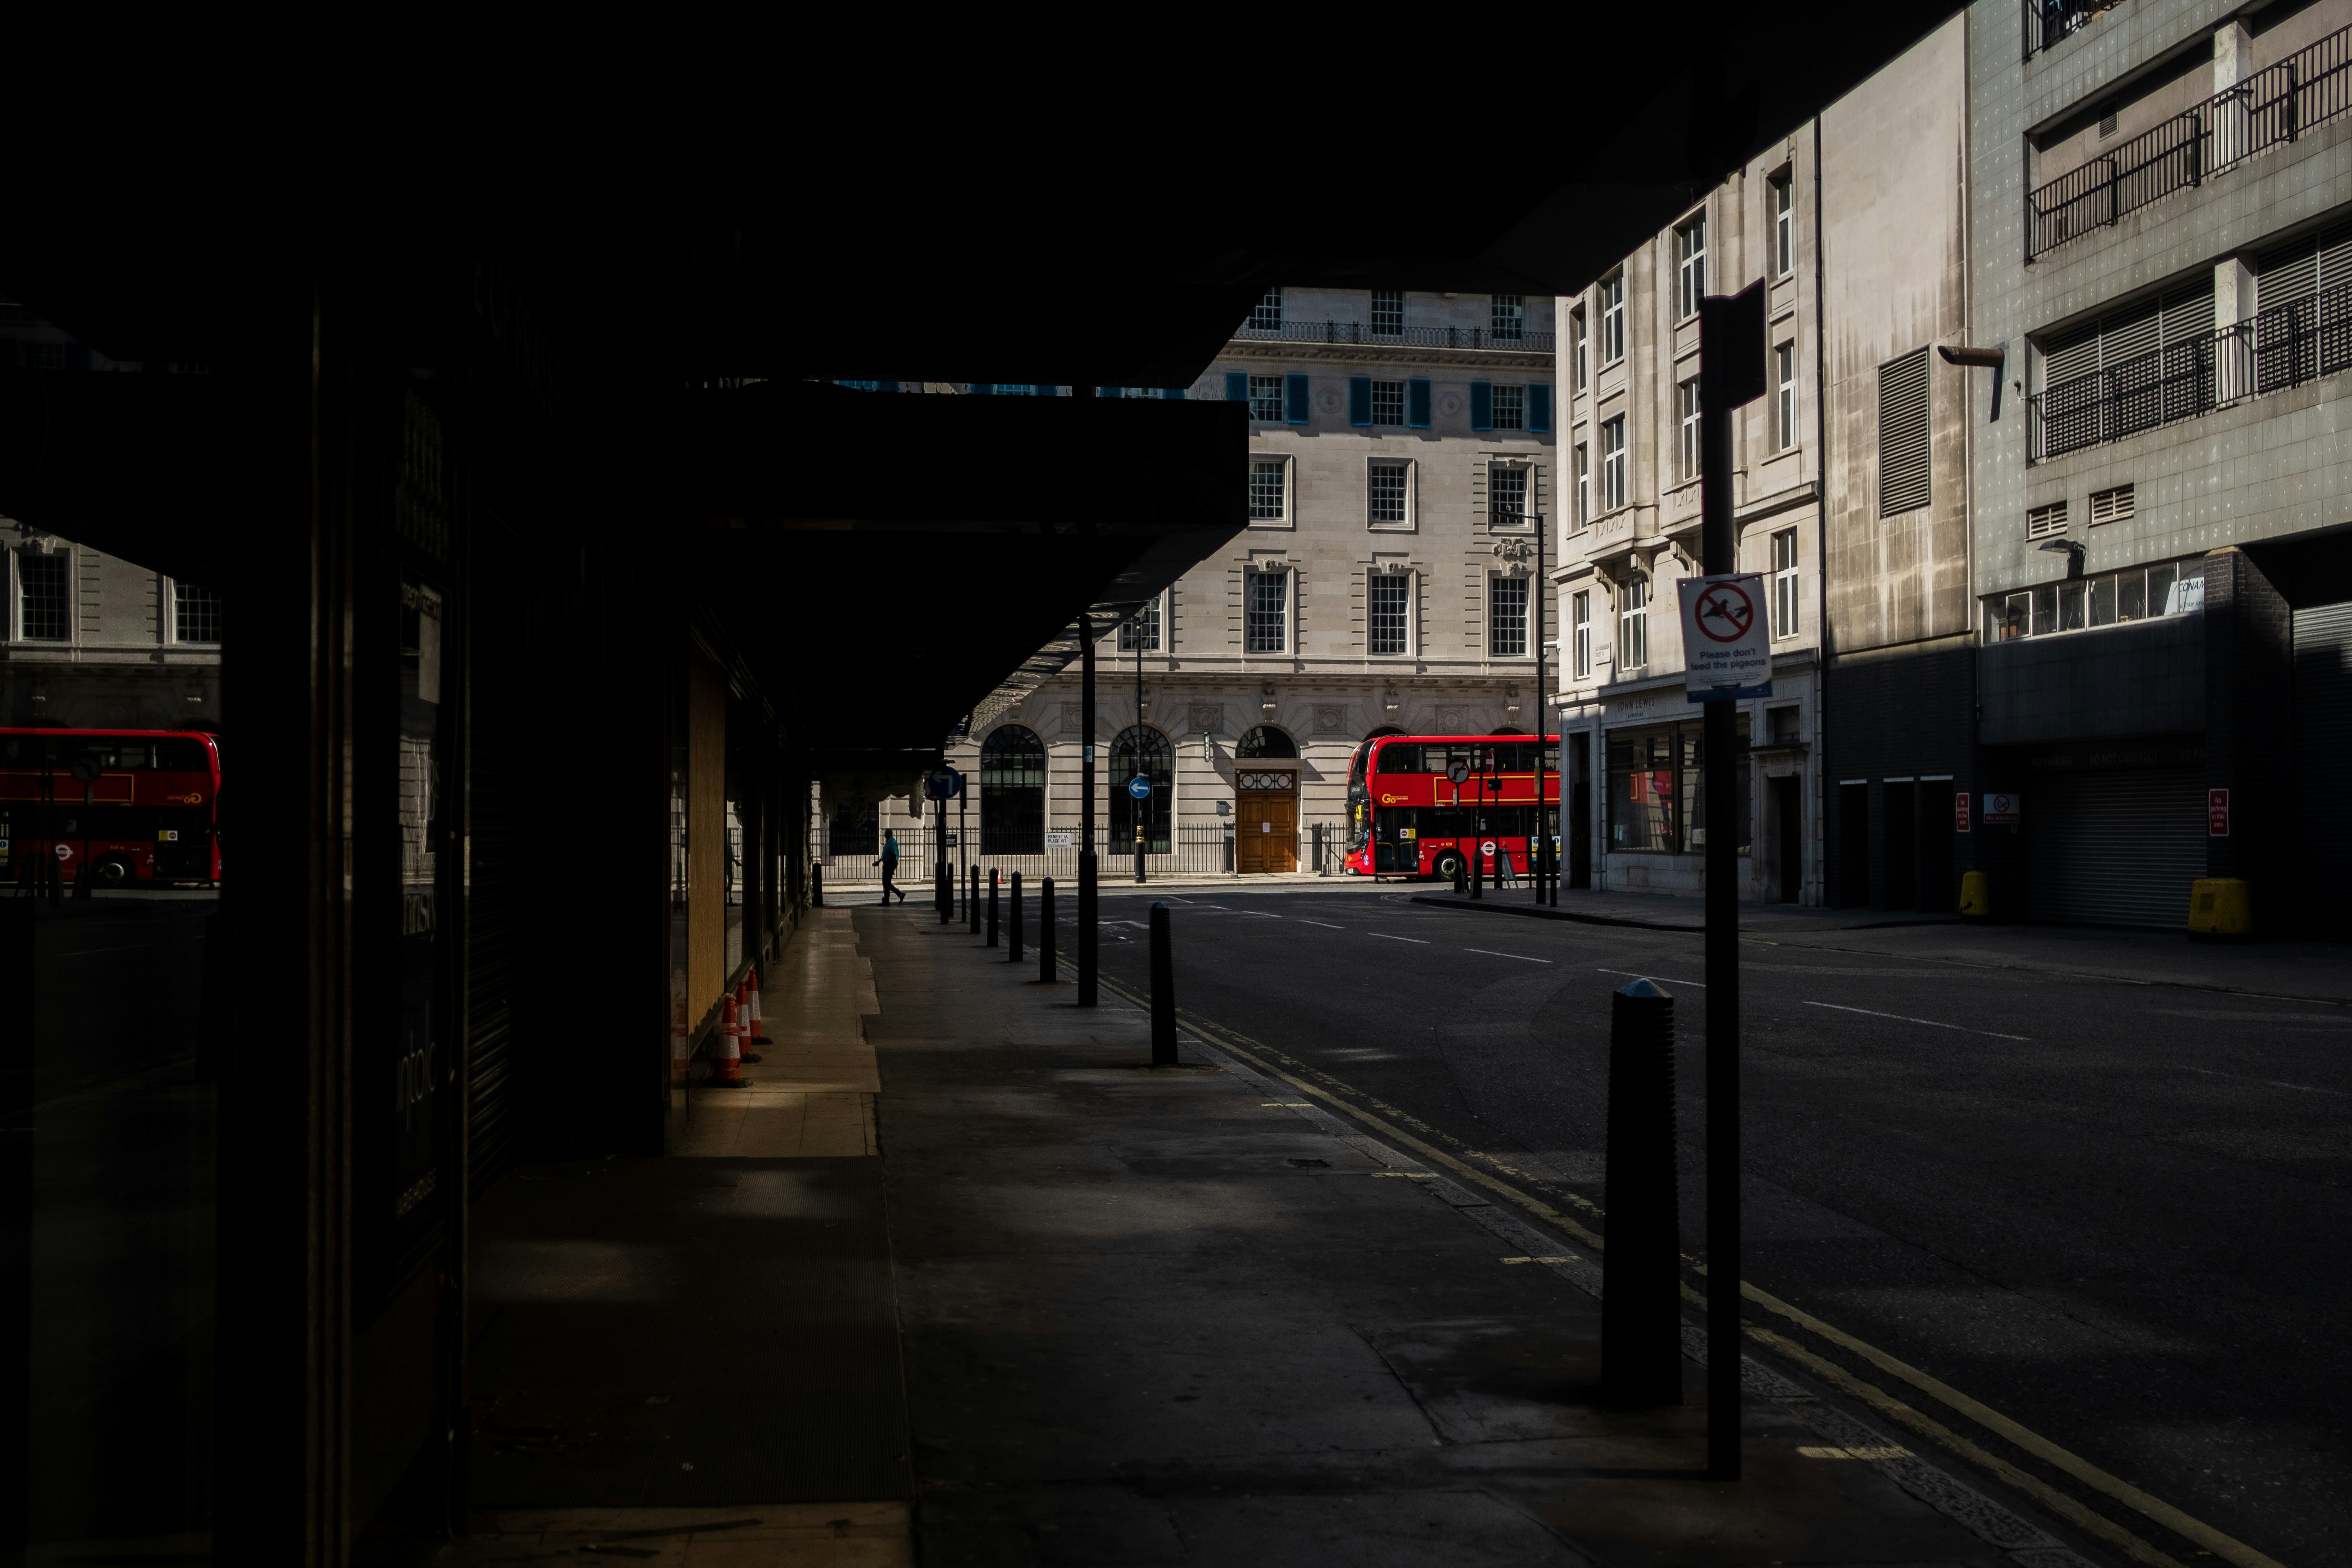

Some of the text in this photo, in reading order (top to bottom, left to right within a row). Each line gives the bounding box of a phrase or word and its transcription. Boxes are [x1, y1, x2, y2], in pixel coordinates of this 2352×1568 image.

[1700, 648, 1756, 659] Please don't
[1691, 658, 1766, 670] feed the pigeons
[1618, 697, 1654, 712] JOHN LEWIS
[2032, 757, 2042, 767] NO
[2043, 755, 2072, 767] PARKING
[2090, 754, 2100, 765] DO
[2102, 753, 2117, 764] NOT
[2119, 751, 2159, 764] OBSTRUCT
[2180, 749, 2191, 760] NO
[1382, 793, 1396, 803] Go
